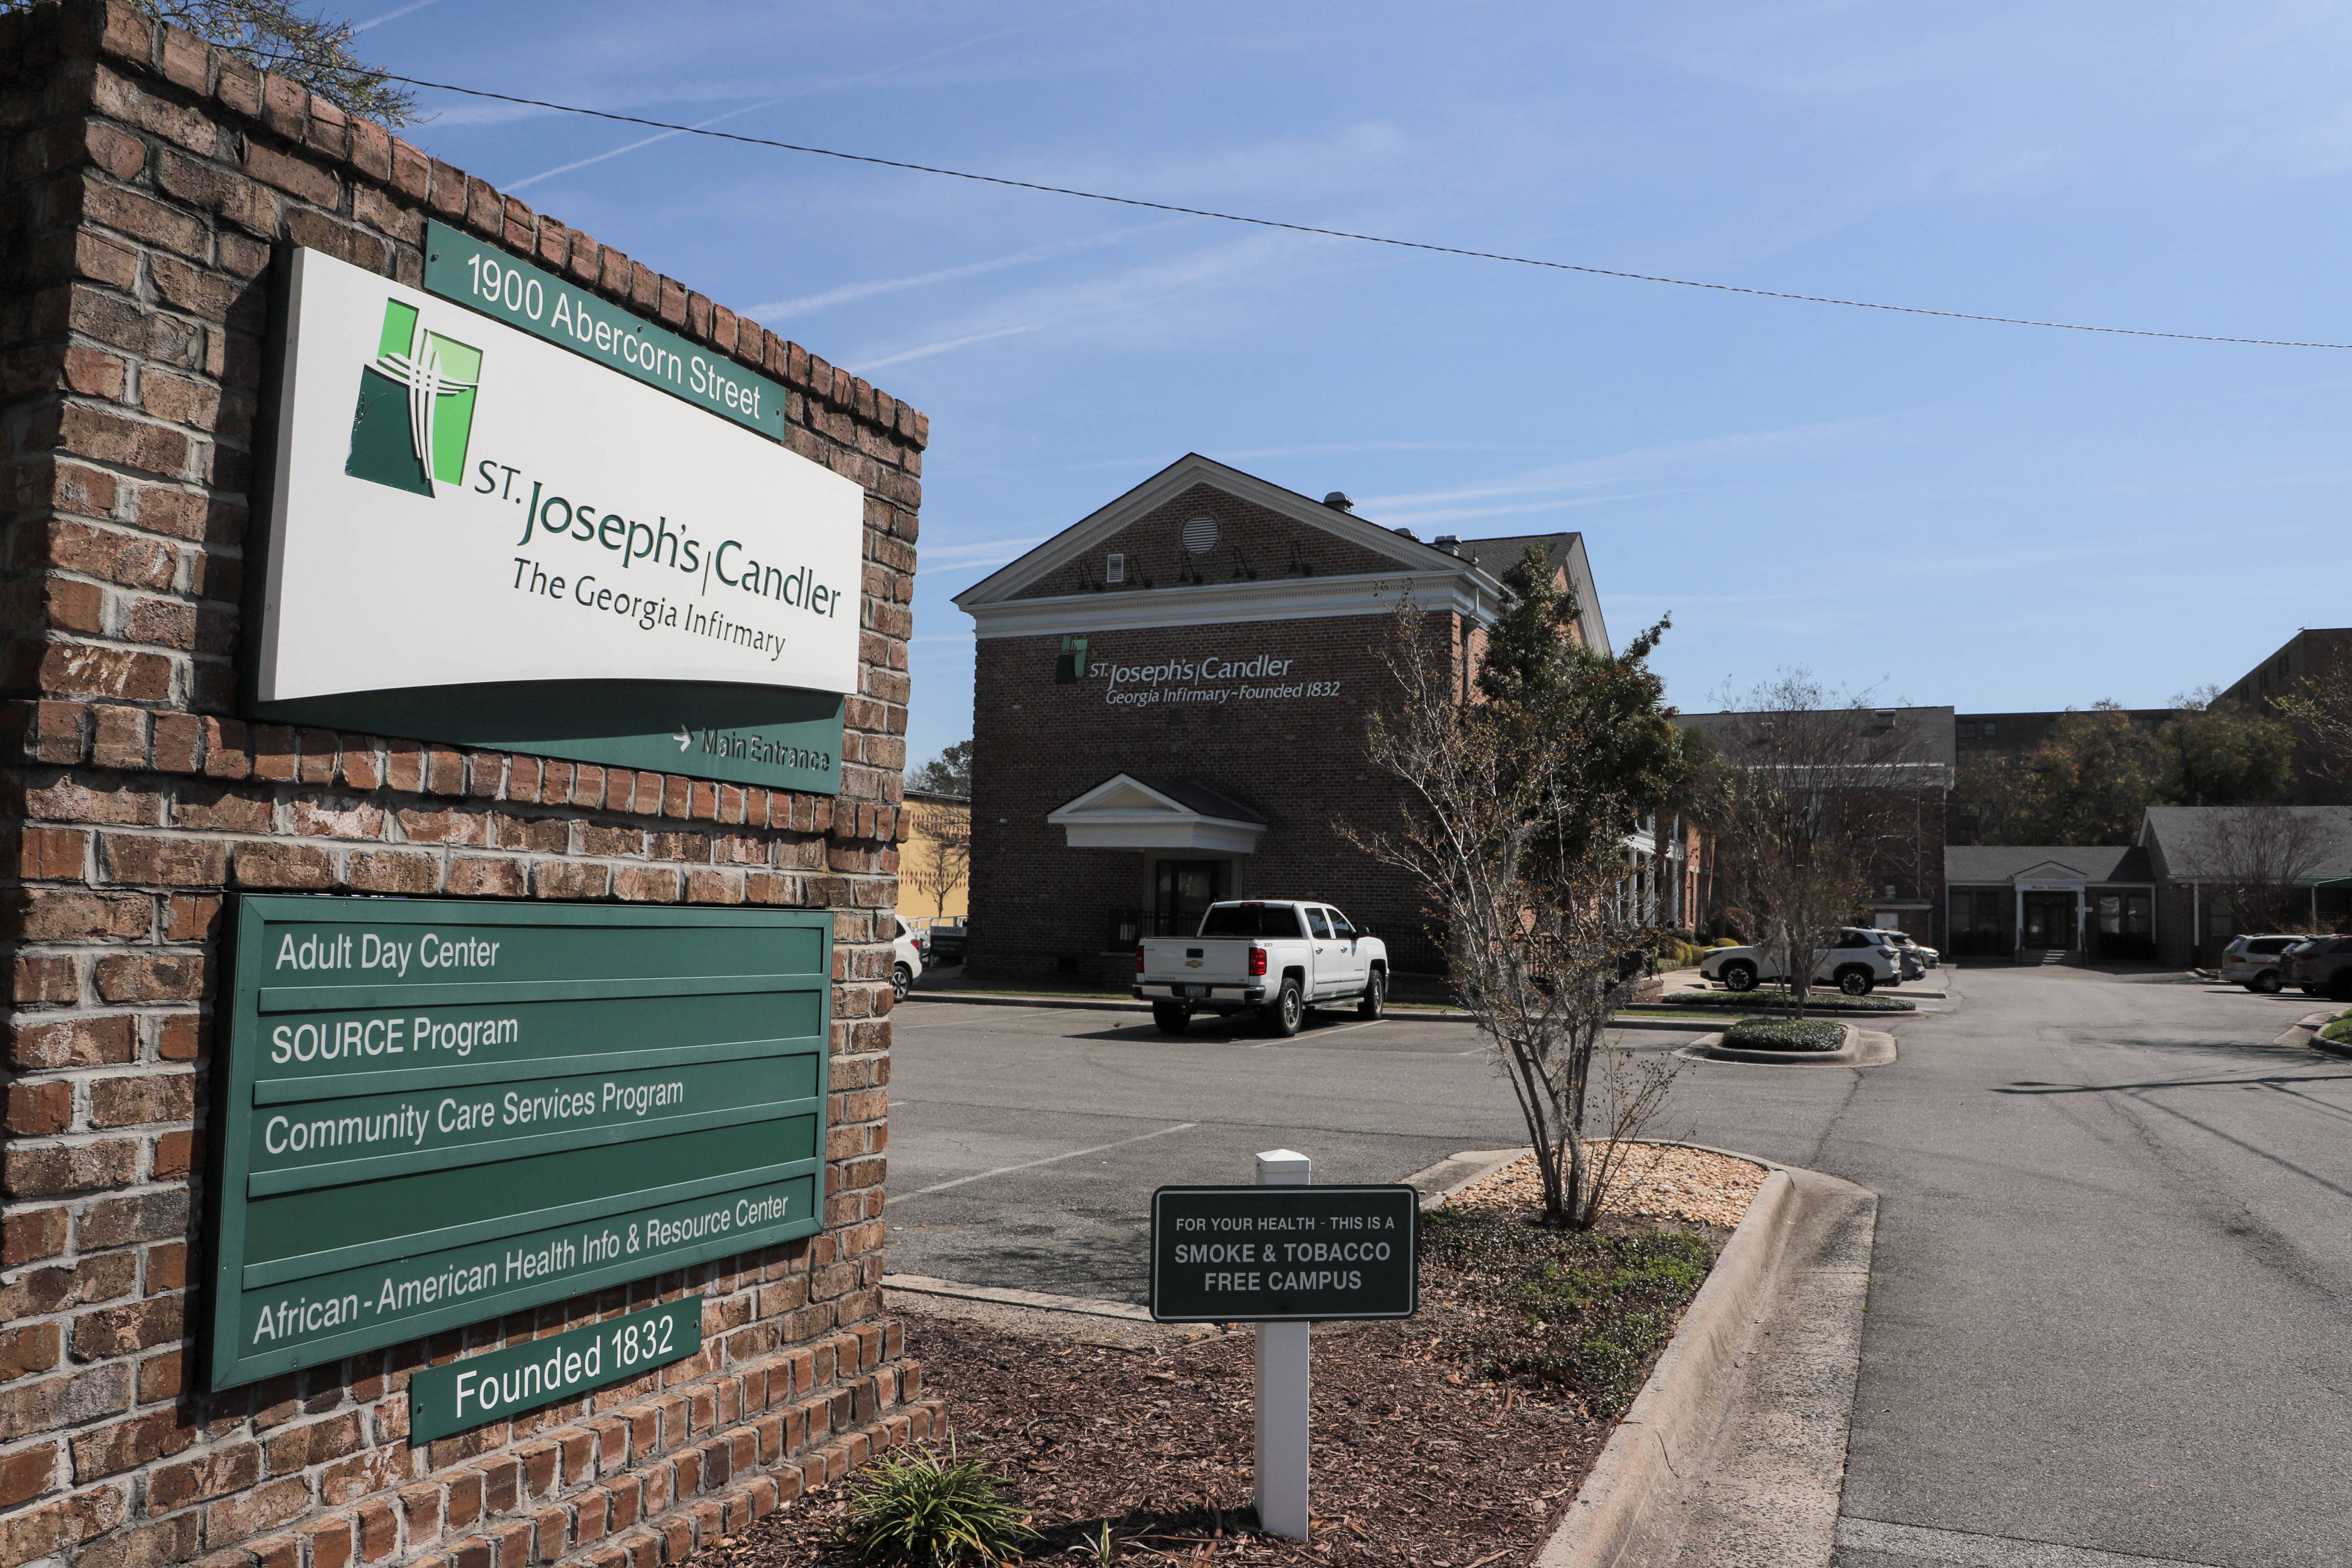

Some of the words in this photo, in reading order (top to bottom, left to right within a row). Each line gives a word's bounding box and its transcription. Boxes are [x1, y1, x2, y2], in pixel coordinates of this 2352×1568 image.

[469, 254, 543, 320] 1900
[551, 292, 681, 384] Abercorn
[690, 356, 760, 419] Street
[475, 460, 521, 504] ST.
[517, 481, 699, 573] Joseph's
[716, 540, 840, 618] Candler
[514, 558, 565, 598] The
[575, 576, 677, 630] Georgia
[686, 604, 785, 661] Infirmary
[1202, 655, 1292, 678] Candler
[1107, 690, 1159, 707] Georgia
[1307, 682, 1340, 696] 1832
[702, 727, 747, 759] Main
[751, 735, 830, 772] Entrance
[276, 934, 352, 970] Adult
[362, 934, 412, 977] Day
[421, 934, 499, 967] Center
[272, 1019, 404, 1063] SOURCE
[414, 1017, 517, 1056] Program
[266, 1104, 429, 1154] Community
[438, 1098, 494, 1132] Care
[503, 1088, 594, 1125] Services
[603, 1082, 683, 1116] Program
[506, 1239, 574, 1282] Health
[583, 1230, 619, 1264] Info
[627, 1224, 639, 1253] &
[647, 1210, 730, 1248] Resource
[736, 1196, 788, 1226] Center
[1177, 1218, 1205, 1230] FOR
[1211, 1218, 1252, 1230] YOUR
[1258, 1217, 1314, 1230] HEALTH
[1330, 1217, 1362, 1229] THIS
[1368, 1217, 1380, 1229] IS
[1385, 1217, 1394, 1228] A
[1175, 1244, 1254, 1263] SMOKE
[1263, 1244, 1276, 1262] &
[1284, 1243, 1390, 1262] TOBACCO
[1206, 1273, 1260, 1291] FREE
[1269, 1271, 1361, 1290] CAMPUS
[457, 1334, 600, 1418] Founded
[612, 1315, 673, 1368] 1832
